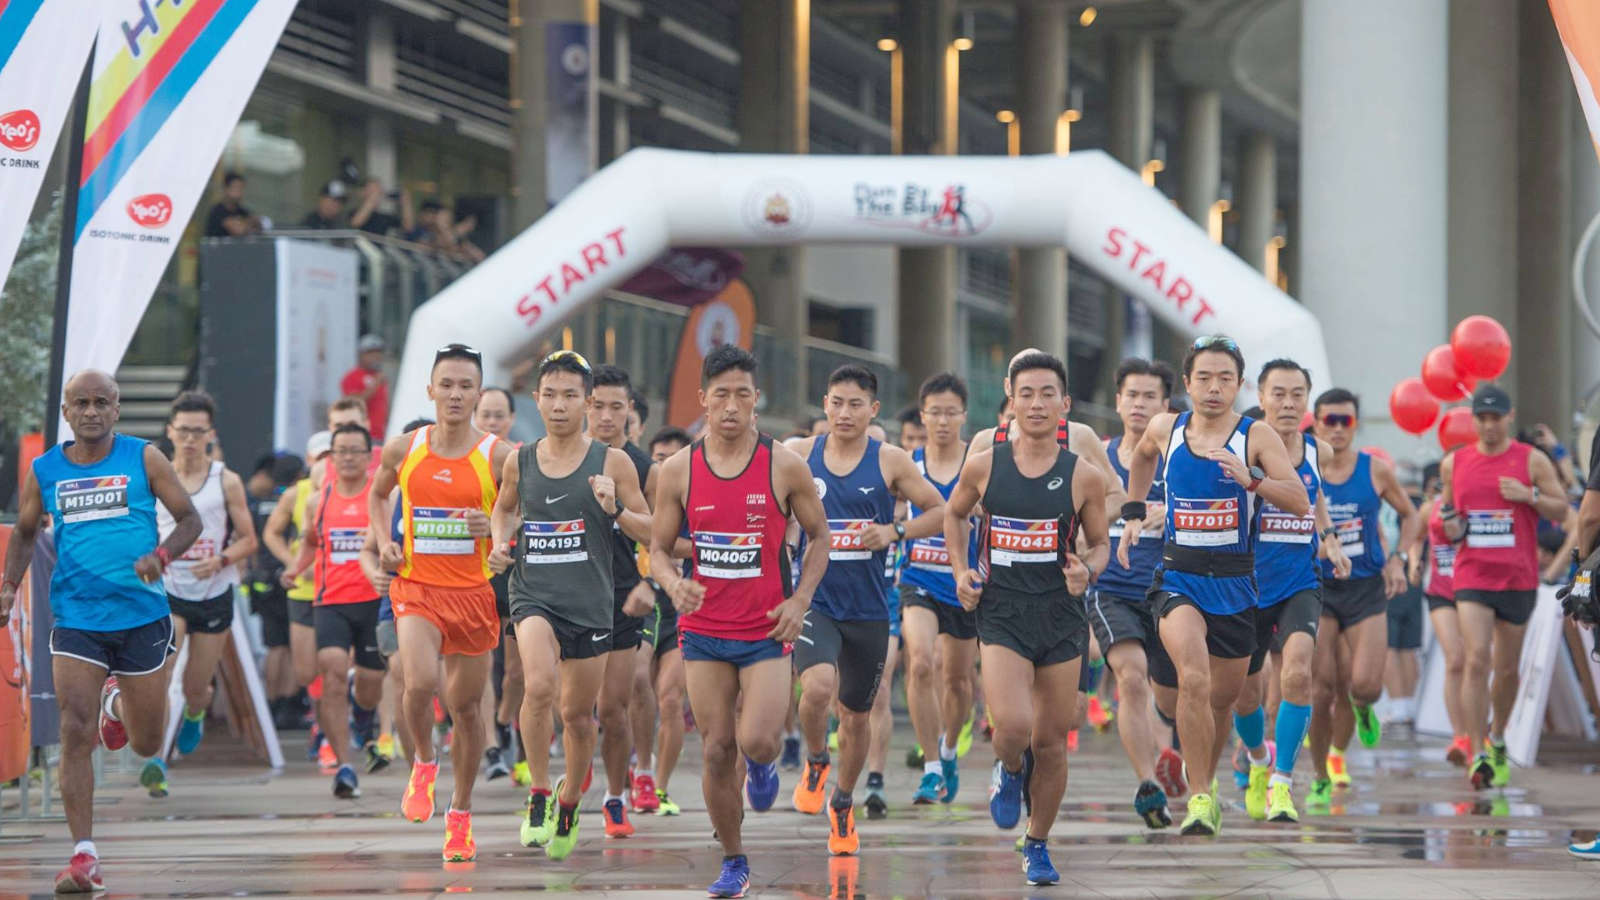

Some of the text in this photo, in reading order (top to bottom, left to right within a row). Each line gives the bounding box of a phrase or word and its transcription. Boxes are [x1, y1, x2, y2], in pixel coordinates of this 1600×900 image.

[9, 158, 41, 169] DRINK
[516, 227, 626, 328] START
[1102, 226, 1215, 326] START
[65, 491, 123, 509] M15001
[1178, 515, 1234, 527] T17019
[528, 536, 581, 549] M04193
[996, 533, 1054, 548] T17042
[700, 549, 758, 564] M04067
